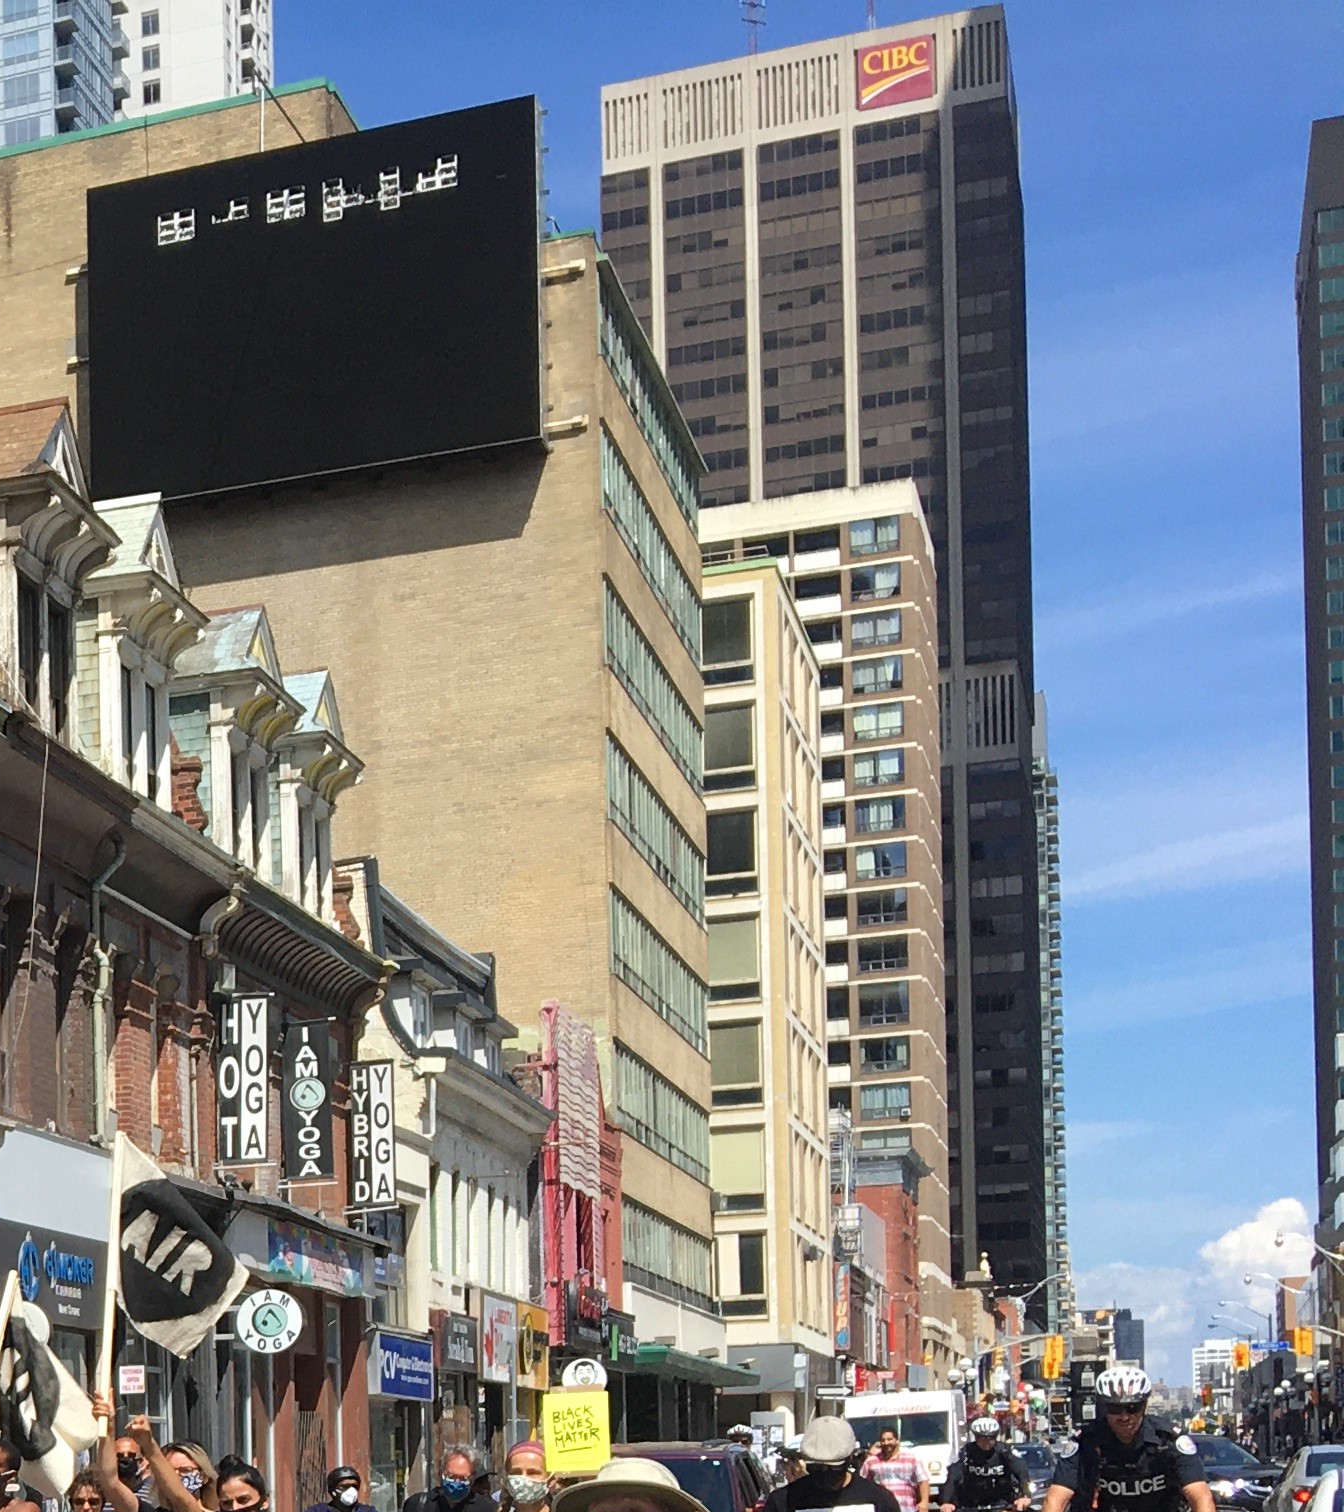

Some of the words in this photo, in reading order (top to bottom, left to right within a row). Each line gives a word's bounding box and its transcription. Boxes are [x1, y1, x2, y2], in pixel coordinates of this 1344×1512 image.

[863, 41, 927, 75] CIBC
[219, 1003, 240, 1158] HOT
[245, 1003, 263, 1156] YOGA
[297, 1110, 322, 1176] YOGA
[352, 1069, 370, 1203] HYBRID
[373, 1067, 391, 1200] YOGA
[121, 1209, 213, 1296] AIR
[244, 1328, 296, 1350] YOGA
[552, 1404, 595, 1424] BLACK
[553, 1417, 593, 1435] LIVES
[554, 1428, 601, 1448] MATTER
[968, 1465, 1005, 1476] POLICE
[1099, 1474, 1166, 1496] POLICE
